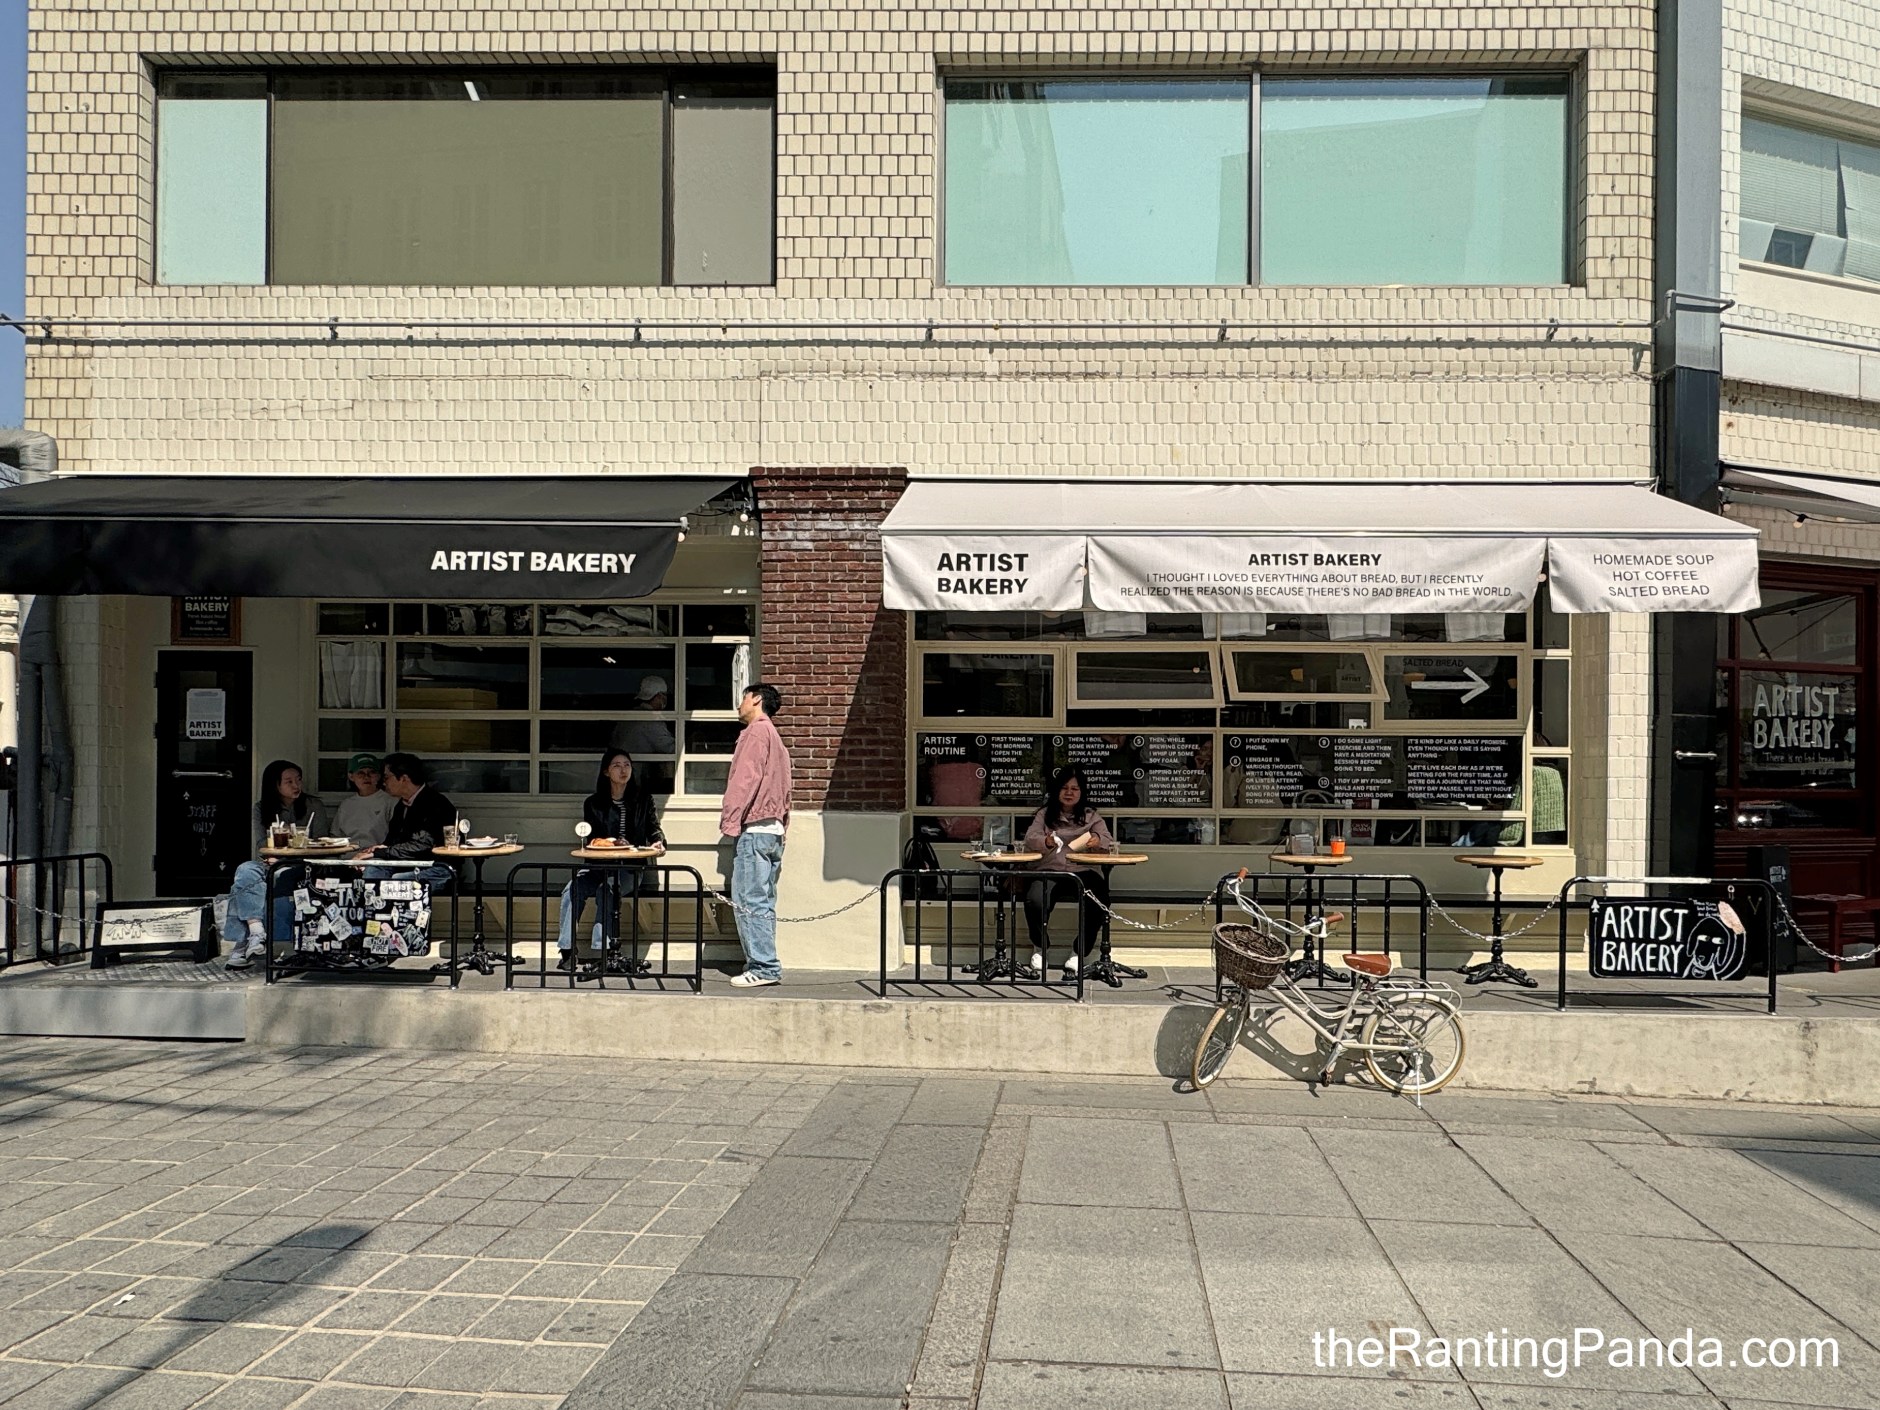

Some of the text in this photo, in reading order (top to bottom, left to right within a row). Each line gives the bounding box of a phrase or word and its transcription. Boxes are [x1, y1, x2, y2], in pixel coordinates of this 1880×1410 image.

[431, 551, 636, 574] ARTIST BAKERY
[937, 553, 1028, 572] ARTIST
[1249, 554, 1382, 566] ARTIST BAKERY
[1593, 554, 1714, 566] HOMEMADE SOUP
[1146, 573, 1483, 584] I THOUGHT I LOVED EVERYTHING ABOUT BREAD, BUT I RECENTLY
[1613, 570, 1699, 582] HOT COFFEE
[938, 578, 1028, 594] BAKERY
[1120, 586, 1513, 597] REALIZED THE REASON IS BECAUSE THERE'S NO BAD BREAD IN THE WORLD.
[1608, 585, 1710, 598] SALTED BREAD
[184, 602, 230, 612] BAKERY
[1752, 684, 1840, 720] ARTIST
[1753, 717, 1840, 750] BAKERY.
[1601, 905, 1688, 942] ARTIST
[1602, 940, 1684, 974] BAKERY
